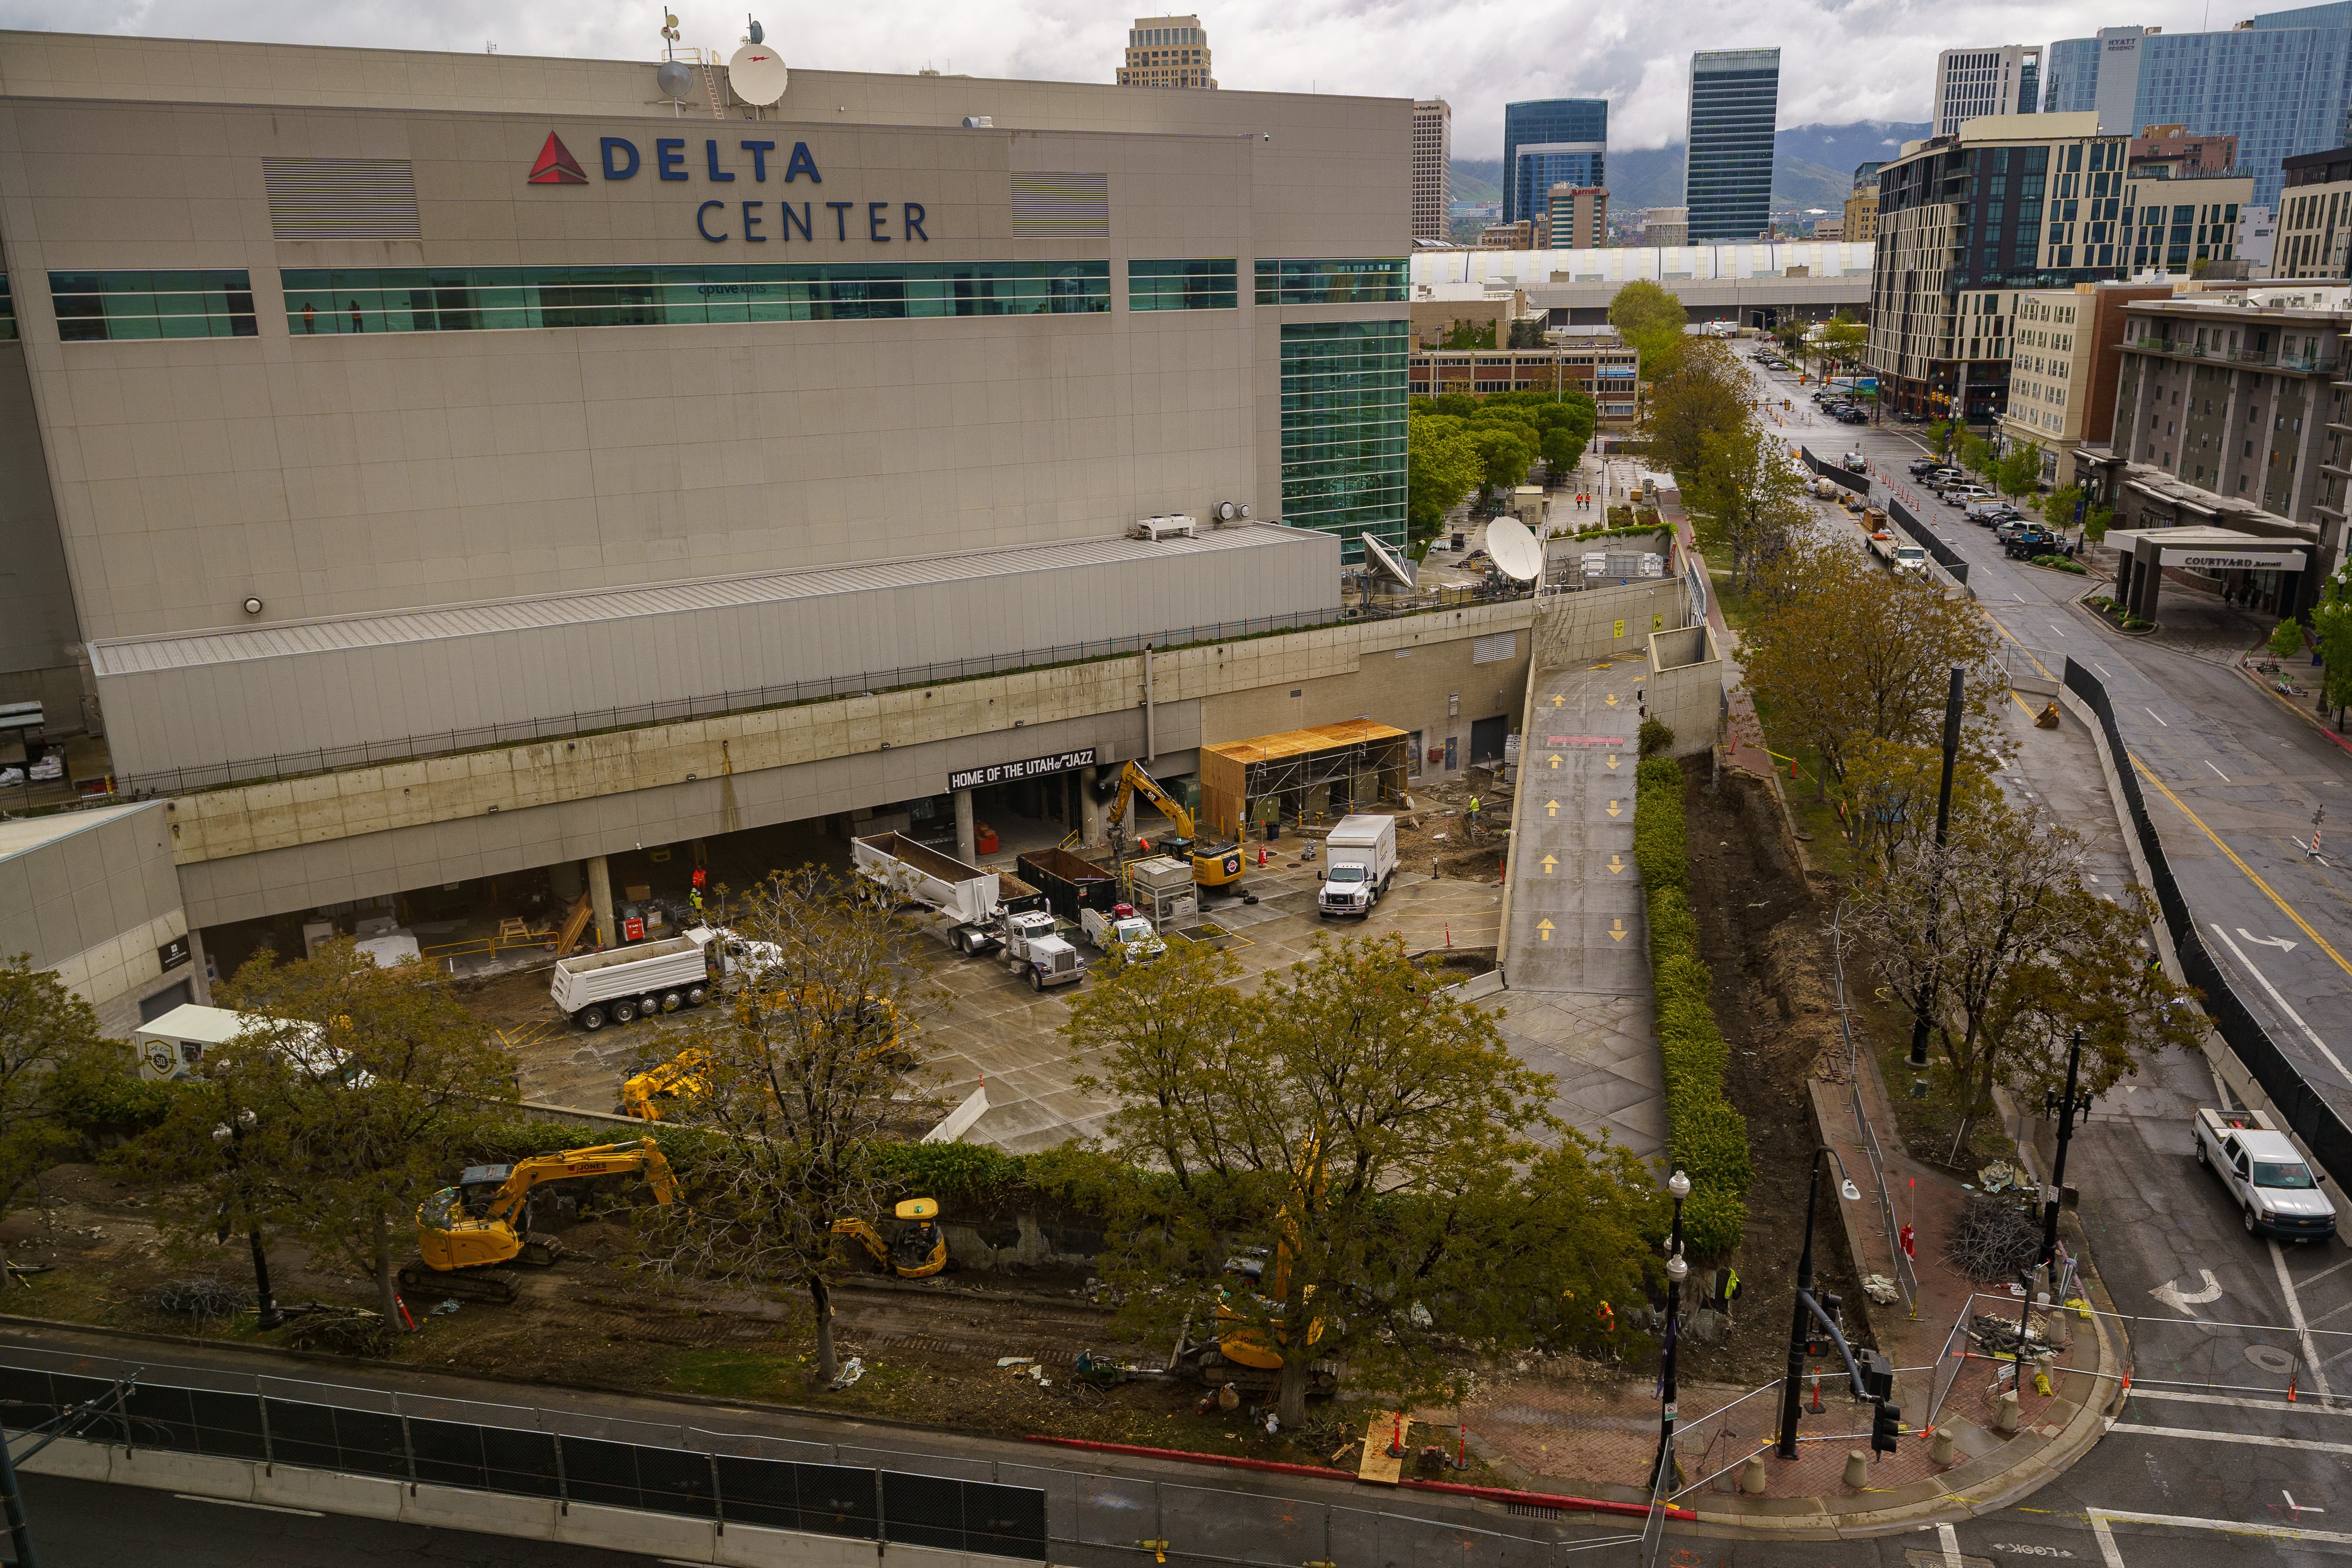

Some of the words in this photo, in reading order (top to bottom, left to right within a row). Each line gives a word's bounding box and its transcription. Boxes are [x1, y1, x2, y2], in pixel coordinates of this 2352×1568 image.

[600, 136, 822, 183] DELTA
[1569, 188, 1600, 196] Marriott
[697, 200, 929, 242] CENTER
[2185, 557, 2252, 567] COURTYARD
[952, 770, 984, 788] HOME
[987, 767, 1001, 781] OF
[1003, 763, 1024, 778] THE
[1027, 757, 1054, 774] UTAH
[1065, 751, 1093, 767] JAZZ
[1147, 791, 1157, 801] CAT
[156, 1057, 165, 1065] 50
[2008, 1543, 2058, 1557] LOOK
